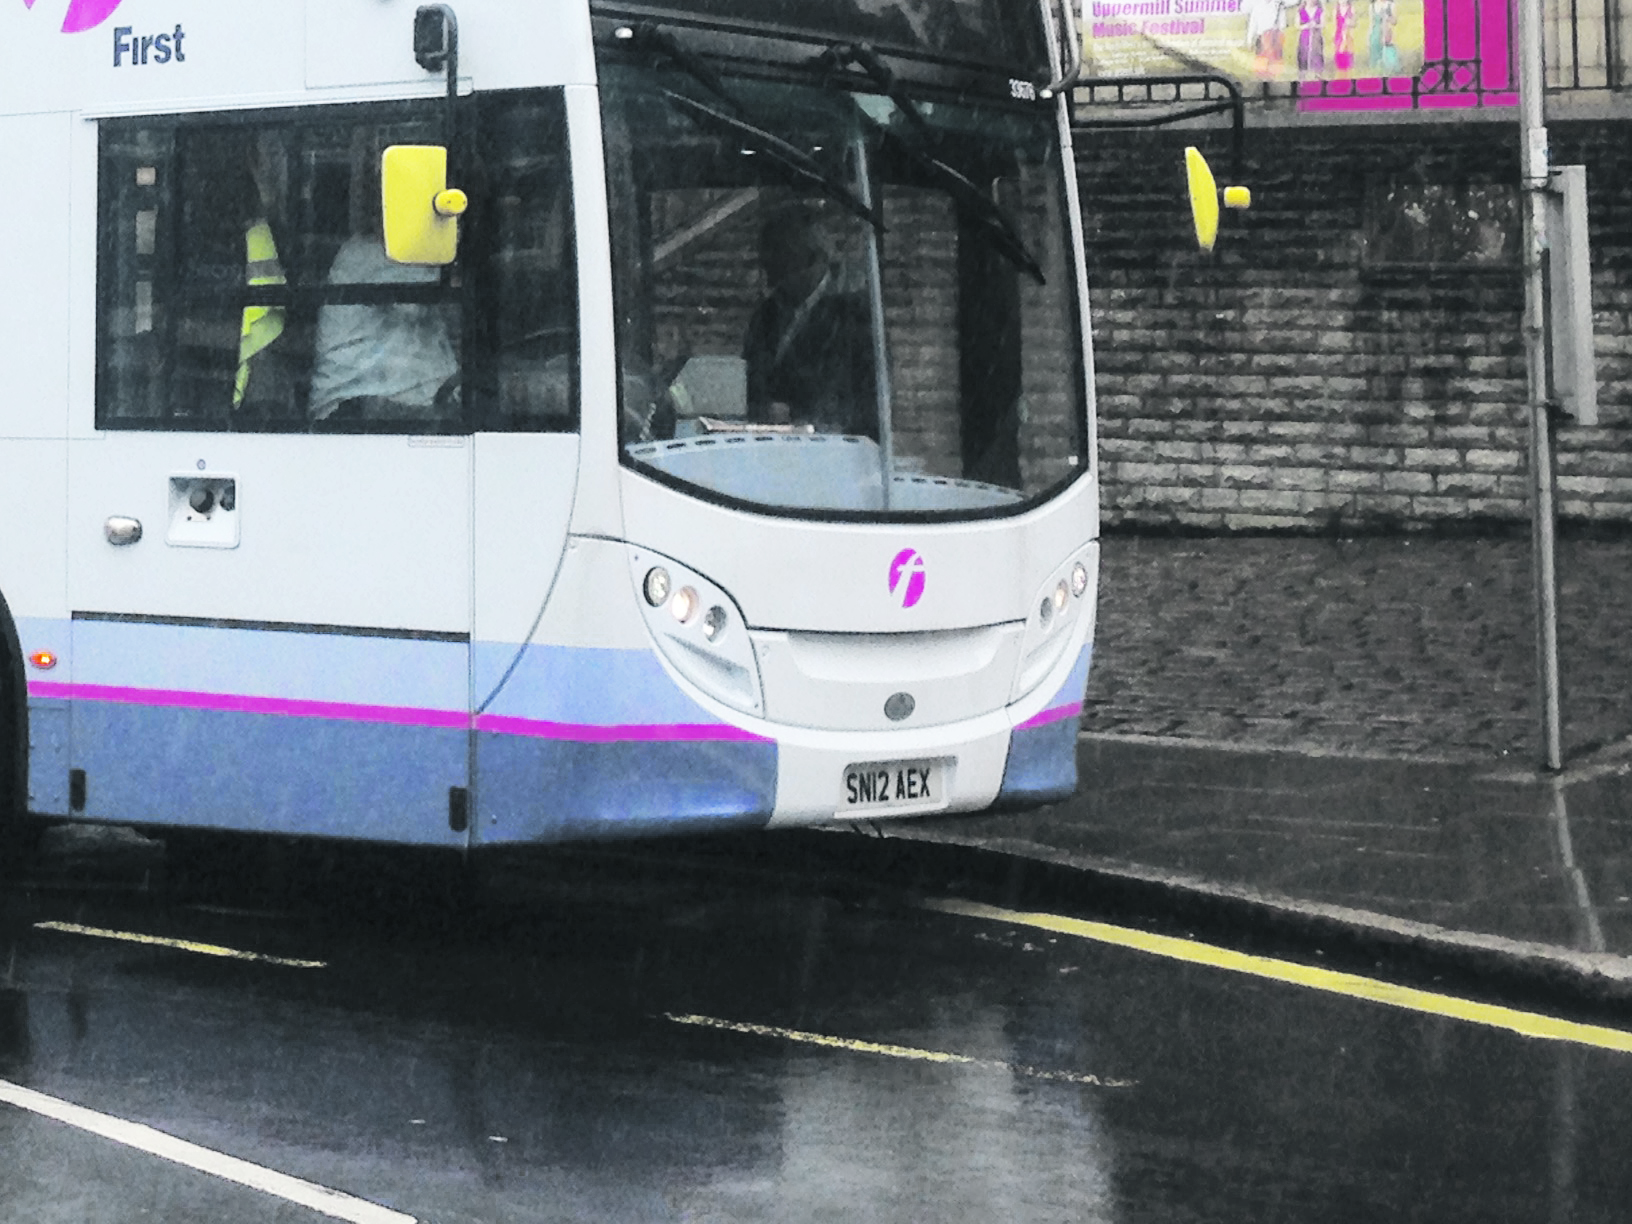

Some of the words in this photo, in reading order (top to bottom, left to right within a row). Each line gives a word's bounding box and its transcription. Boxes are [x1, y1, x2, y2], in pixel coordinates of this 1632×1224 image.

[1092, 0, 1170, 17] Uppermill
[1092, 19, 1137, 39] Music
[1142, 19, 1205, 35] Festival
[113, 23, 186, 68] First
[846, 770, 889, 803] SN12
[895, 768, 930, 800] AEX
